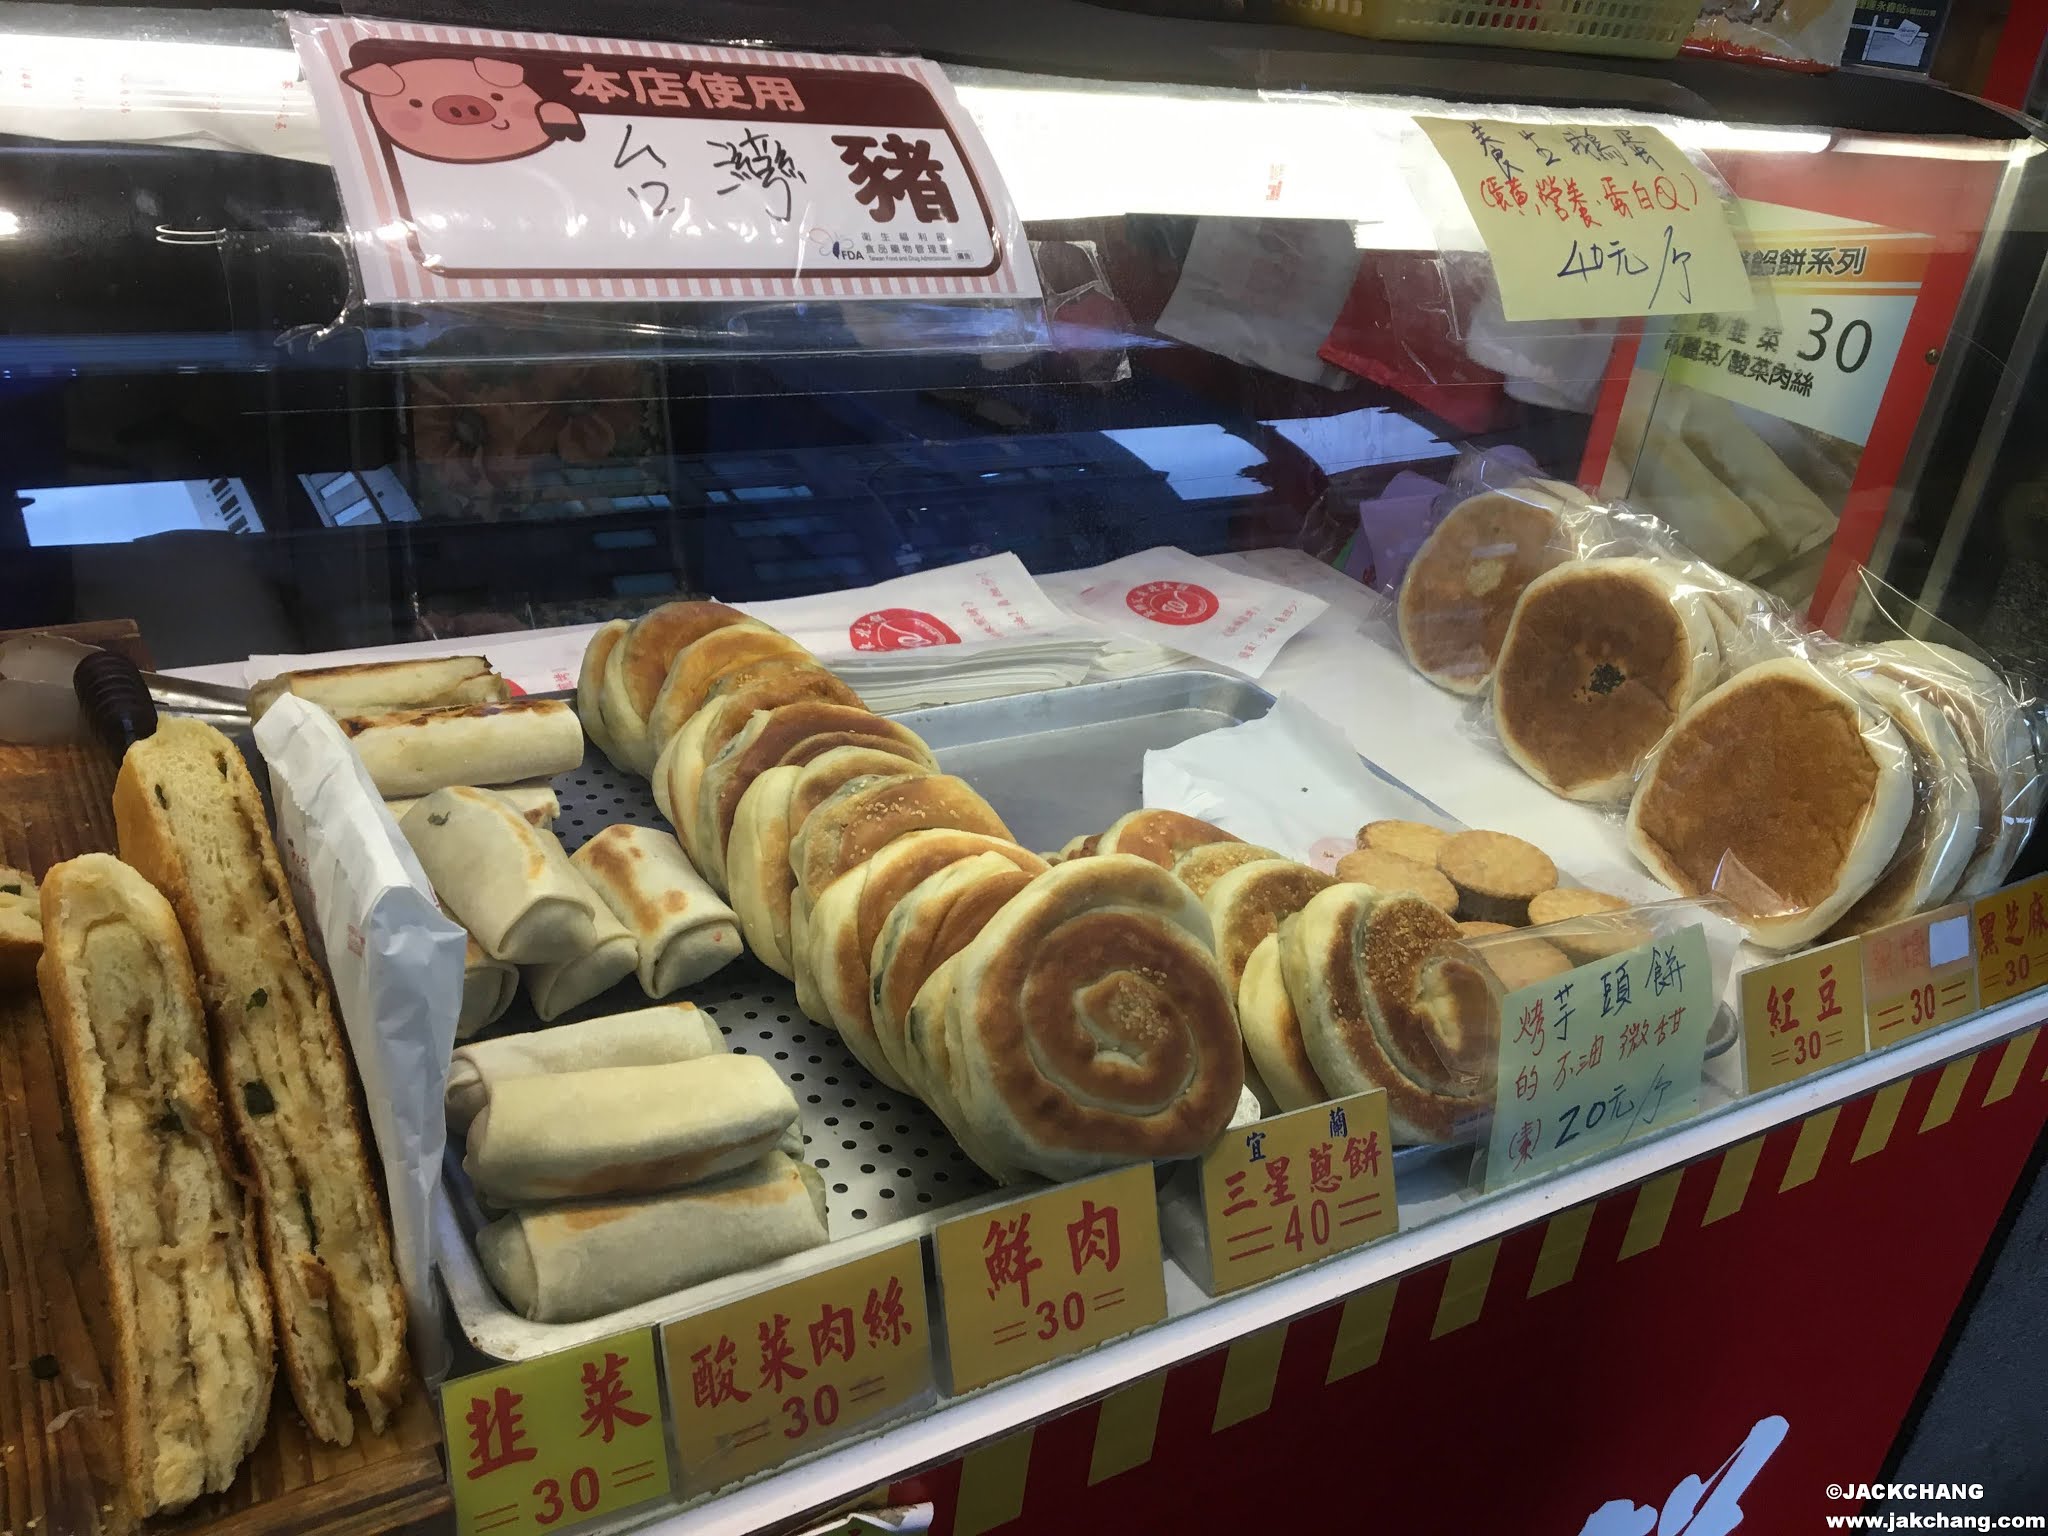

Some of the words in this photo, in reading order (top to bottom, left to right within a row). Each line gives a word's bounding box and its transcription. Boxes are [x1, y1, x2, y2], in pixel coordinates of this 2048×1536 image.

[563, 64, 807, 112] 本店使用
[614, 124, 807, 222] 台灣
[831, 134, 961, 224] 豬
[841, 250, 865, 260] FDA
[861, 232, 947, 242] 衛生福利部
[865, 244, 949, 254] 食品藥物管理署
[1797, 308, 1873, 373] 30
[1767, 964, 1843, 1037] 紅豆
[983, 1200, 1121, 1308] 鮮肉
[690, 1276, 912, 1408] 酸菜肉絲
[466, 1353, 652, 1480] 韭菜
